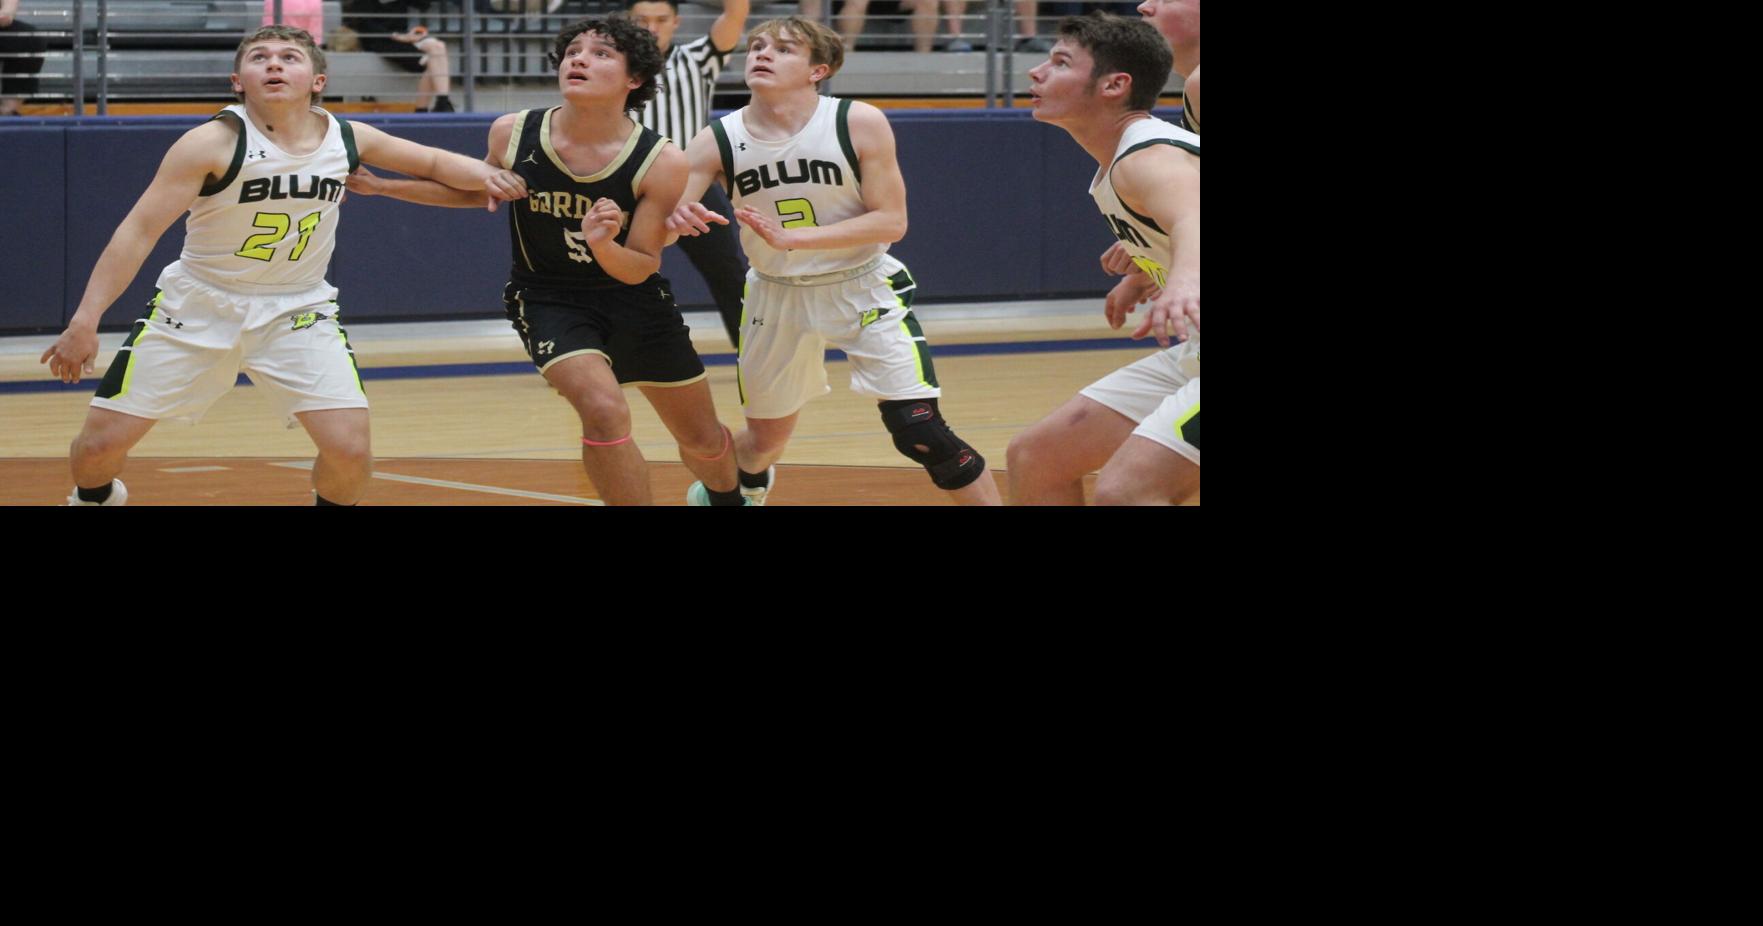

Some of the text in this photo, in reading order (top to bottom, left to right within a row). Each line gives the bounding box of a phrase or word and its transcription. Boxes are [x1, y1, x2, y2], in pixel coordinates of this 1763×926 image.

[238, 174, 342, 204] BLUM
[735, 158, 843, 197] BLUM
[528, 188, 630, 230] GORD
[234, 211, 321, 262] 21
[563, 227, 593, 264] 5
